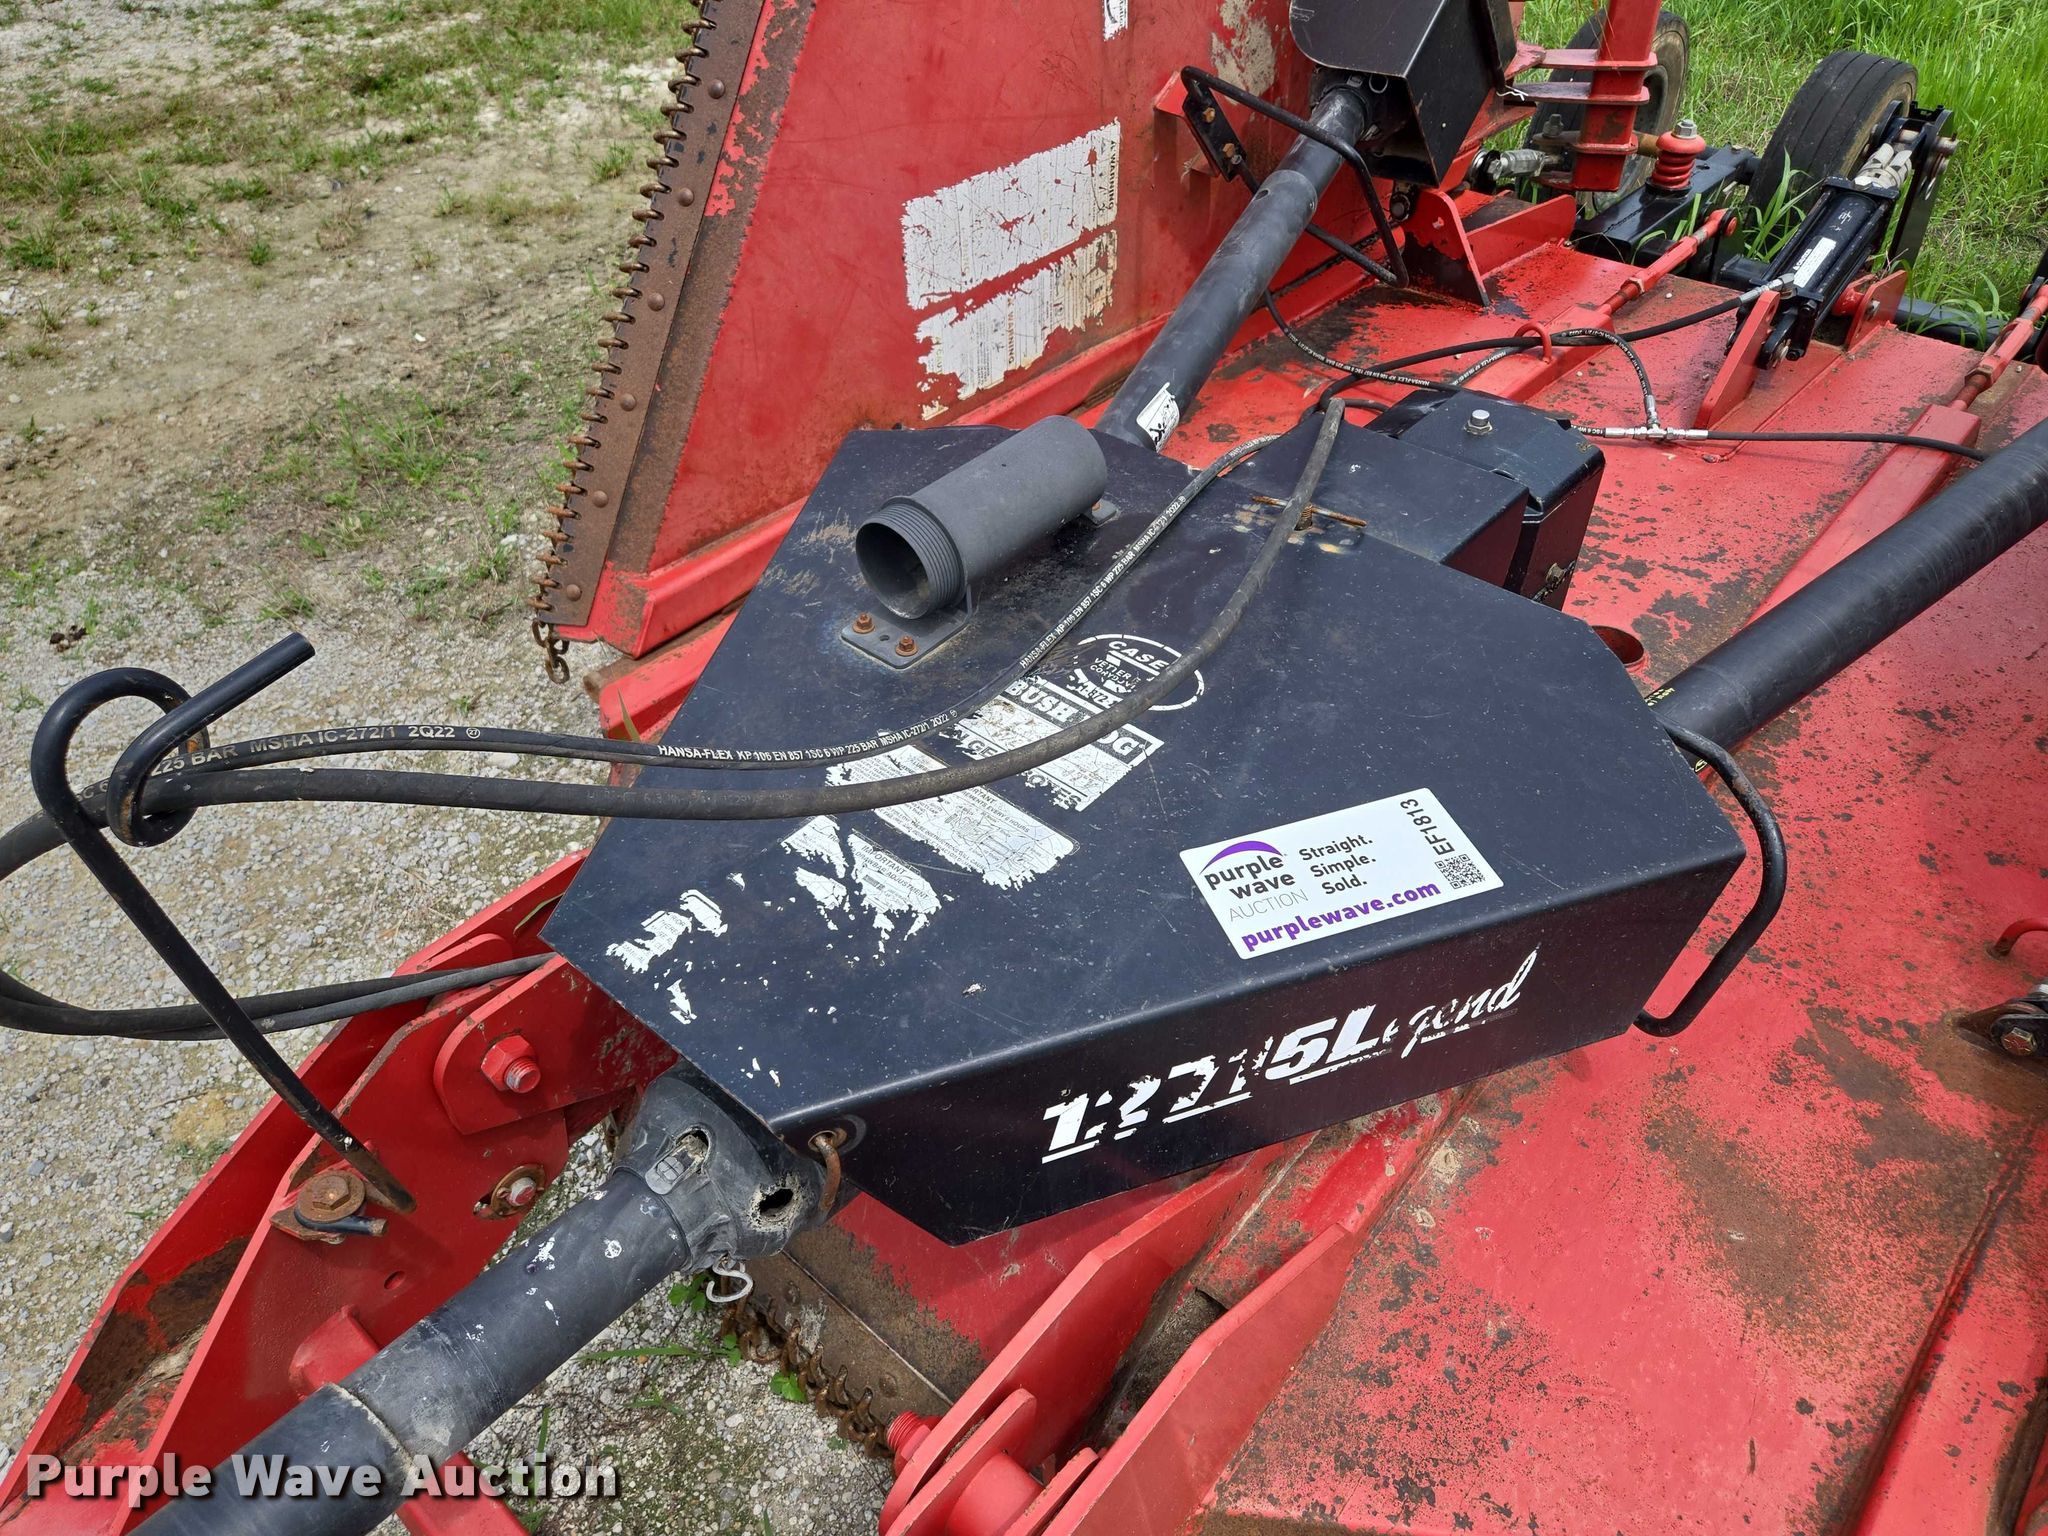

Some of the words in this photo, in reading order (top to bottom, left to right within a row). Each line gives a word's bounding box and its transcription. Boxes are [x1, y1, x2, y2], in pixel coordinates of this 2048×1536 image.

[1108, 153, 1116, 209] WARNING
[1007, 312, 1015, 364] WARNING
[1020, 632, 1057, 668] HANSA-FLEX
[1081, 596, 1092, 609] 857
[1004, 679, 1080, 723] BUSH
[191, 745, 239, 766] BAR
[250, 732, 314, 753] MSHA
[318, 726, 396, 744] IC-272/1
[408, 726, 455, 739] 2Q22
[657, 745, 734, 760] HANSA-FLEX
[774, 751, 788, 761] EN
[789, 750, 804, 761] 857
[806, 748, 824, 760] 1SC
[846, 743, 861, 755] 225
[861, 739, 878, 752] BAR
[879, 732, 904, 746] MSHA
[1400, 798, 1455, 855] EF1813
[862, 845, 906, 875] IMPORTANT
[1299, 833, 1373, 862] Straight.
[1204, 854, 1285, 890] purple
[1309, 855, 1376, 879] Simple.
[1228, 872, 1295, 900] wave
[1322, 876, 1367, 895] Sold.
[1229, 889, 1309, 922] AUCTION
[1241, 881, 1441, 951] purplewave.com
